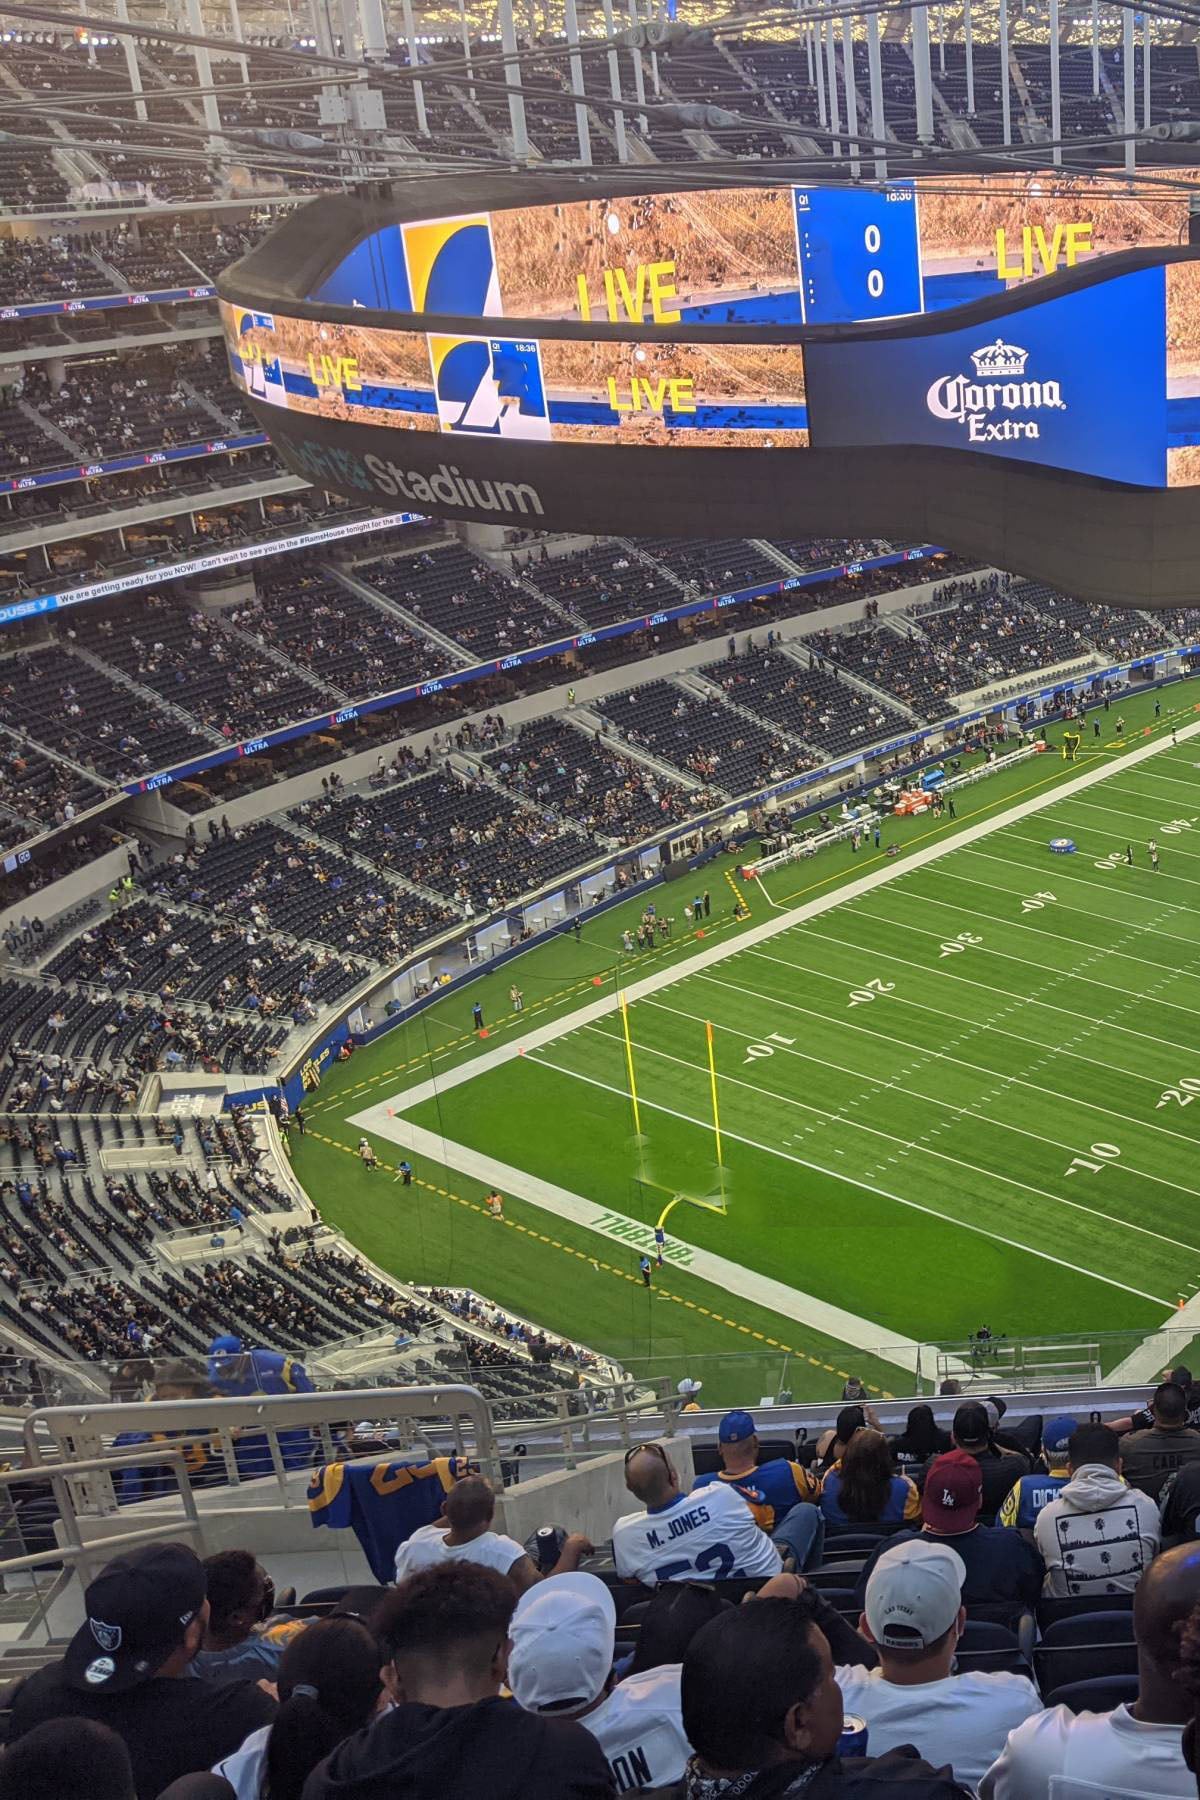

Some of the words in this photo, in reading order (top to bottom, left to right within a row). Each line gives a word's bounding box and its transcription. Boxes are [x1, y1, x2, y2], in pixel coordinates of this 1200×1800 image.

[864, 224, 881, 253] 0
[867, 269, 884, 298] 0
[307, 351, 362, 391] LIVE
[607, 376, 697, 413] LIVE
[927, 374, 1064, 424] Corona
[967, 413, 1040, 441] Extra
[363, 453, 546, 516] Stadium
[60, 594, 74, 604] We
[76, 591, 90, 600] are
[91, 582, 121, 597] getting
[121, 575, 144, 590] ready
[159, 570, 174, 580] you
[174, 565, 197, 576] NOW!
[202, 557, 222, 568] Can't
[222, 553, 239, 564] wait
[263, 545, 278, 556] you
[299, 529, 346, 545] #RamsHouse
[346, 523, 371, 537] tonight
[907, 552, 924, 561] ULTRA
[847, 566, 863, 575] ULTRA
[783, 581, 800, 590] ULTRA
[718, 597, 736, 607] ULTRA
[650, 616, 667, 626] ULTRA
[577, 636, 597, 648] ULTRA
[501, 658, 522, 670] ULTRA
[421, 683, 443, 695] ULTRA
[335, 710, 359, 724] ULTRA
[243, 740, 269, 755] ULTRA
[147, 775, 173, 790] ULTRA
[646, 1531, 665, 1549] M.
[668, 1506, 711, 1538] JONES
[884, 1606, 896, 1615] LAS
